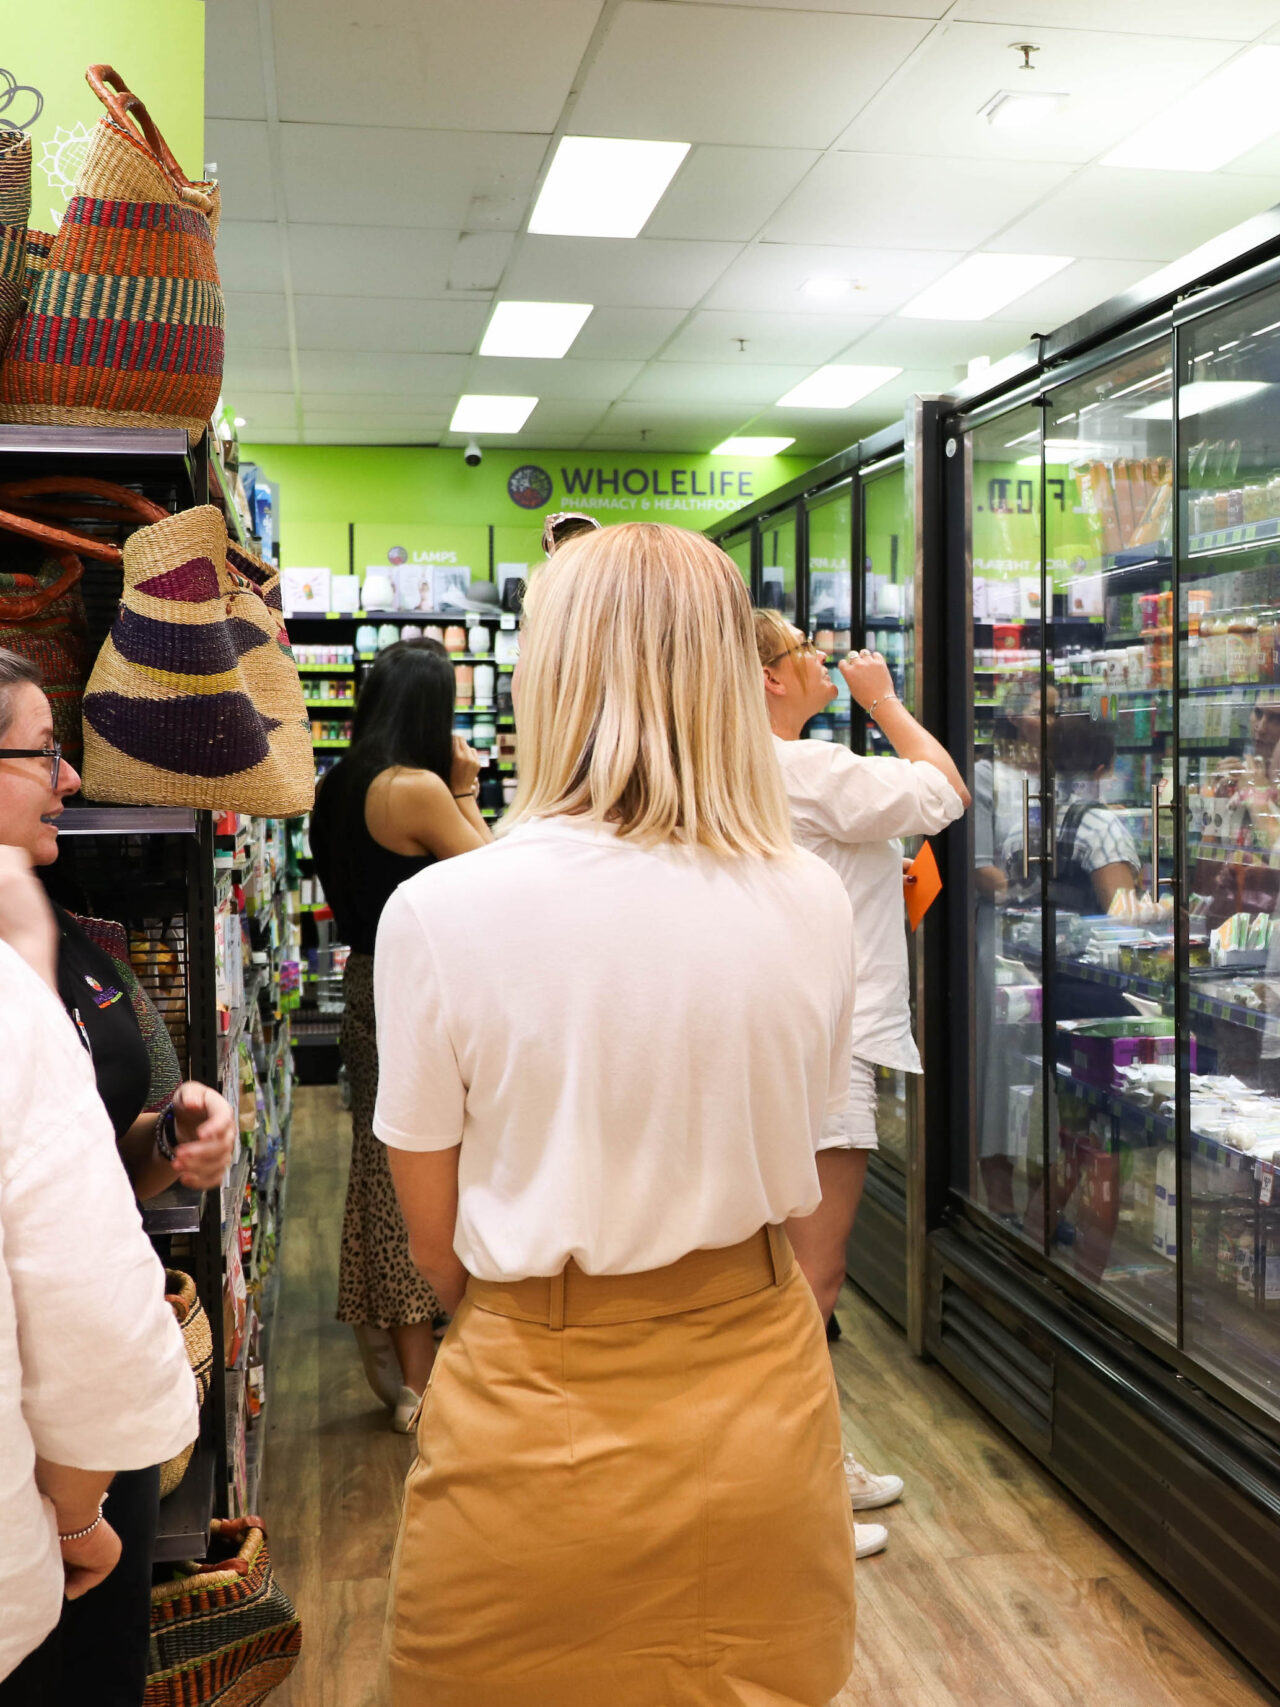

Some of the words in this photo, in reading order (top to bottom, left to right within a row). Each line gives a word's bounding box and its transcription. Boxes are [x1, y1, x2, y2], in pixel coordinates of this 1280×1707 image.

[561, 467, 753, 497] WHOLELIFE
[561, 497, 637, 511] PHARMACY
[641, 498, 650, 510] &
[412, 550, 458, 565] LAMPS
